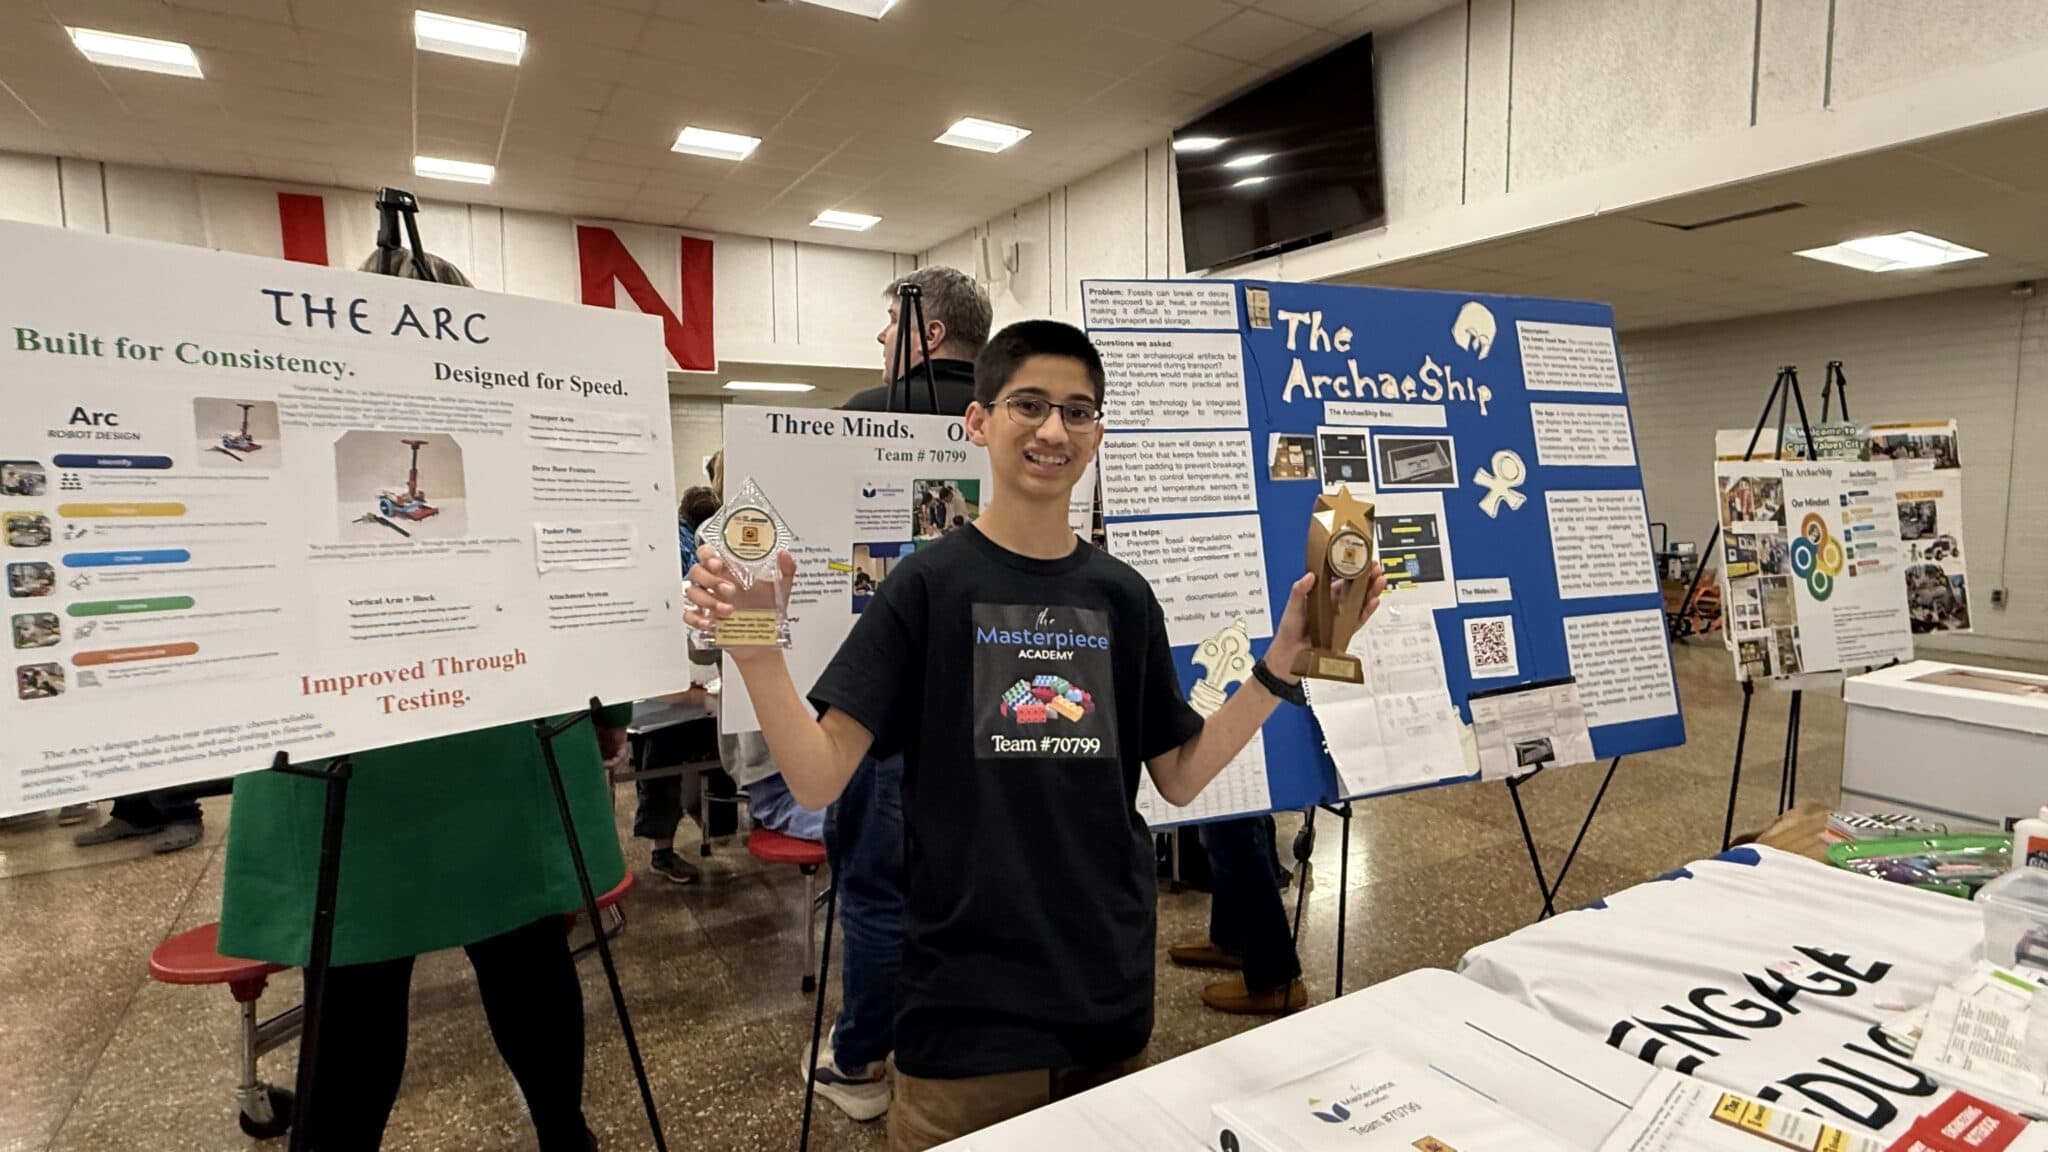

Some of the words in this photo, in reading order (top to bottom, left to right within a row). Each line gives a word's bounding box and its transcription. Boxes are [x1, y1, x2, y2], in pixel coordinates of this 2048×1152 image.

[576, 225, 715, 371] N
[261, 288, 372, 335] THE
[392, 303, 489, 344] ARC
[1278, 310, 1353, 352] The
[14, 326, 104, 358] Built
[115, 336, 164, 362] for
[175, 342, 355, 381] Consistency.
[434, 361, 529, 389] Designed
[536, 371, 564, 391] for
[570, 374, 628, 401] Speed.
[1282, 355, 1493, 416] ArchaeShip
[69, 406, 119, 426] Arc
[766, 412, 834, 436] Three
[842, 417, 914, 439] Minds.
[1329, 409, 1341, 417] The
[48, 430, 92, 440] ROBOT
[96, 431, 140, 441] DESIGN
[875, 448, 913, 462] Team
[917, 450, 924, 462] #
[929, 450, 966, 463] 70799
[1462, 587, 1472, 595] The
[976, 627, 1109, 649] Masterpiece
[1018, 650, 1074, 660] ACADEMY
[301, 660, 425, 696] Improved
[432, 648, 528, 677] Through
[377, 687, 471, 716] Testing.
[992, 736, 1036, 752] Team
[1040, 737, 1100, 753] #70799
[1606, 945, 1894, 1076] ENGAGE
